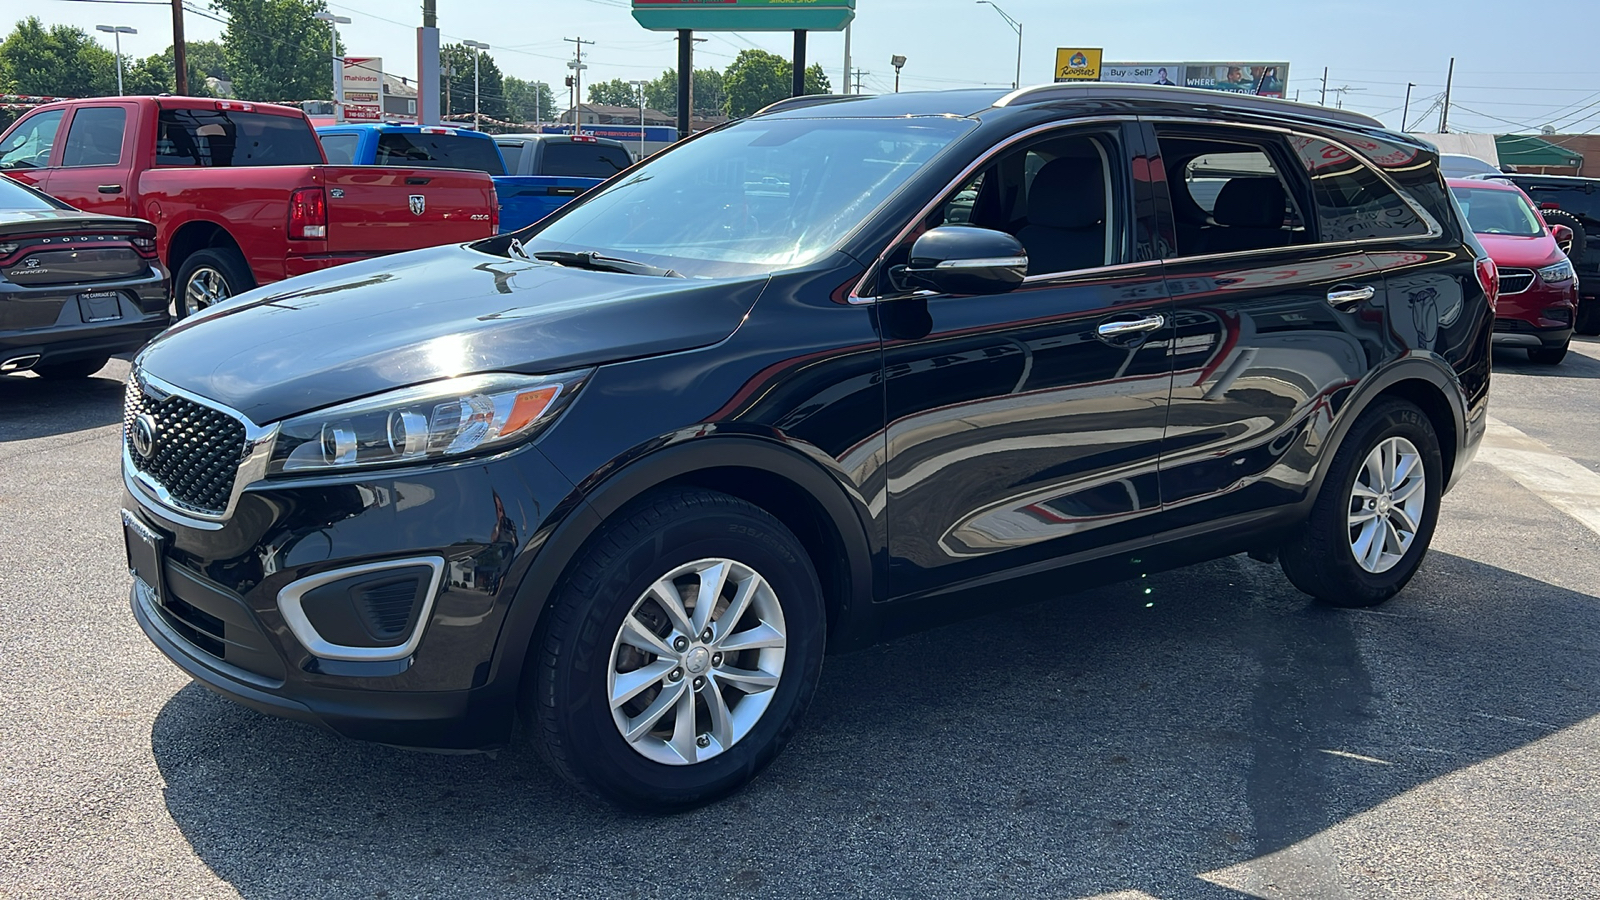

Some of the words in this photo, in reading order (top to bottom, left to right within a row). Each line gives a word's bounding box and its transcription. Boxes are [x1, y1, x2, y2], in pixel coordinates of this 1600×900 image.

[1061, 66, 1096, 77] Roosters
[1110, 69, 1127, 77] Buy
[1134, 68, 1154, 77] Sell?
[1186, 78, 1216, 86] WHERE
[10, 268, 49, 276] CHARGER
[1401, 410, 1435, 438] KELLY
